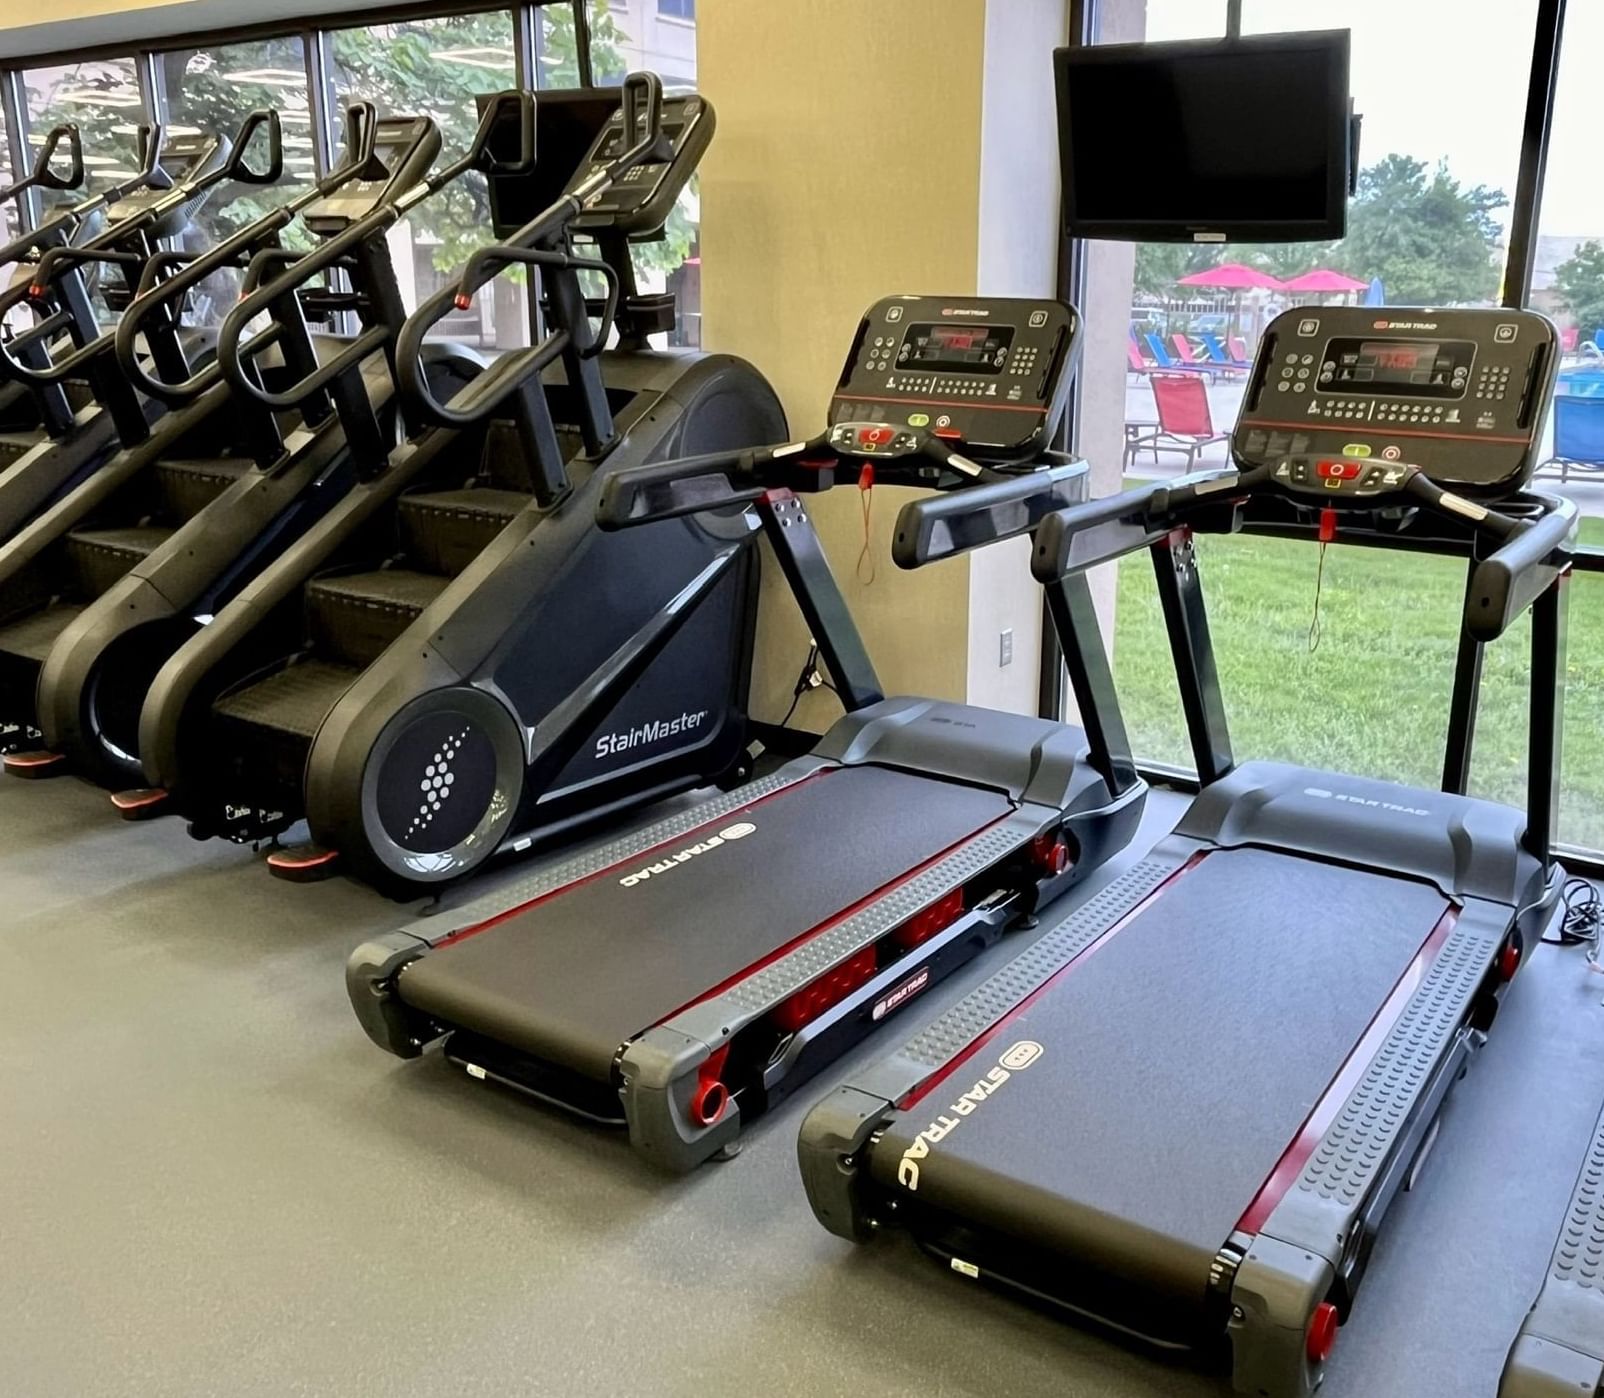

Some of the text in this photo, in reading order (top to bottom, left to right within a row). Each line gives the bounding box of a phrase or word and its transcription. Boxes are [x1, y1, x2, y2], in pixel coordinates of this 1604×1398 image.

[1413, 322, 1438, 331] TRAC
[595, 711, 705, 759] StairMaster
[1335, 794, 1430, 816] STAR TRAC
[619, 835, 726, 887] STAR TRAC
[886, 972, 929, 1008] STAR TRAC
[898, 1066, 1012, 1192] STAR TRAC
